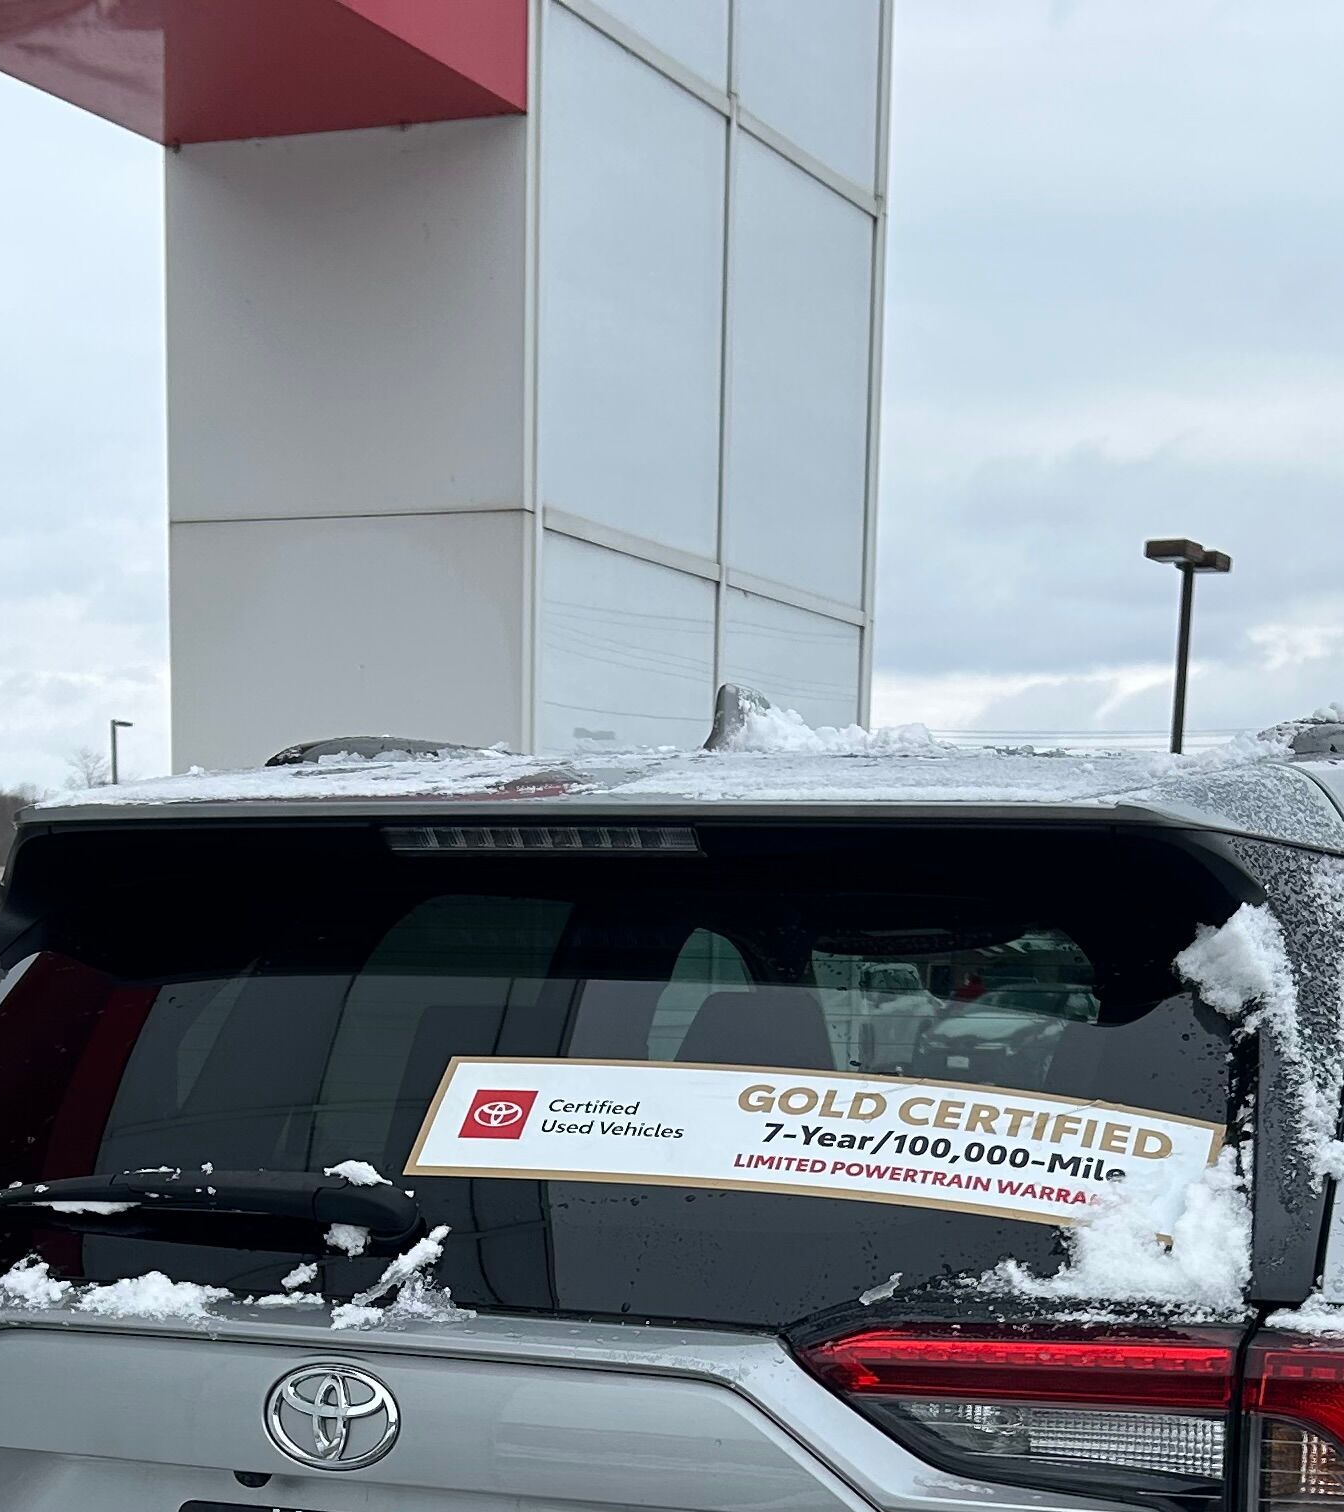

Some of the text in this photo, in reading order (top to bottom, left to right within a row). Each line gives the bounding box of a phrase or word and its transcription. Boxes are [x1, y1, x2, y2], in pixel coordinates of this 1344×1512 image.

[540, 1119, 685, 1139] Used Vehicles
[548, 1098, 641, 1116] Certified
[737, 1083, 1173, 1160] GOLD CERTIFIED
[762, 1122, 1126, 1183] 7-Year/100,000-Mile
[733, 1153, 1101, 1207] LIMITED POWERTRAIN WARRA
